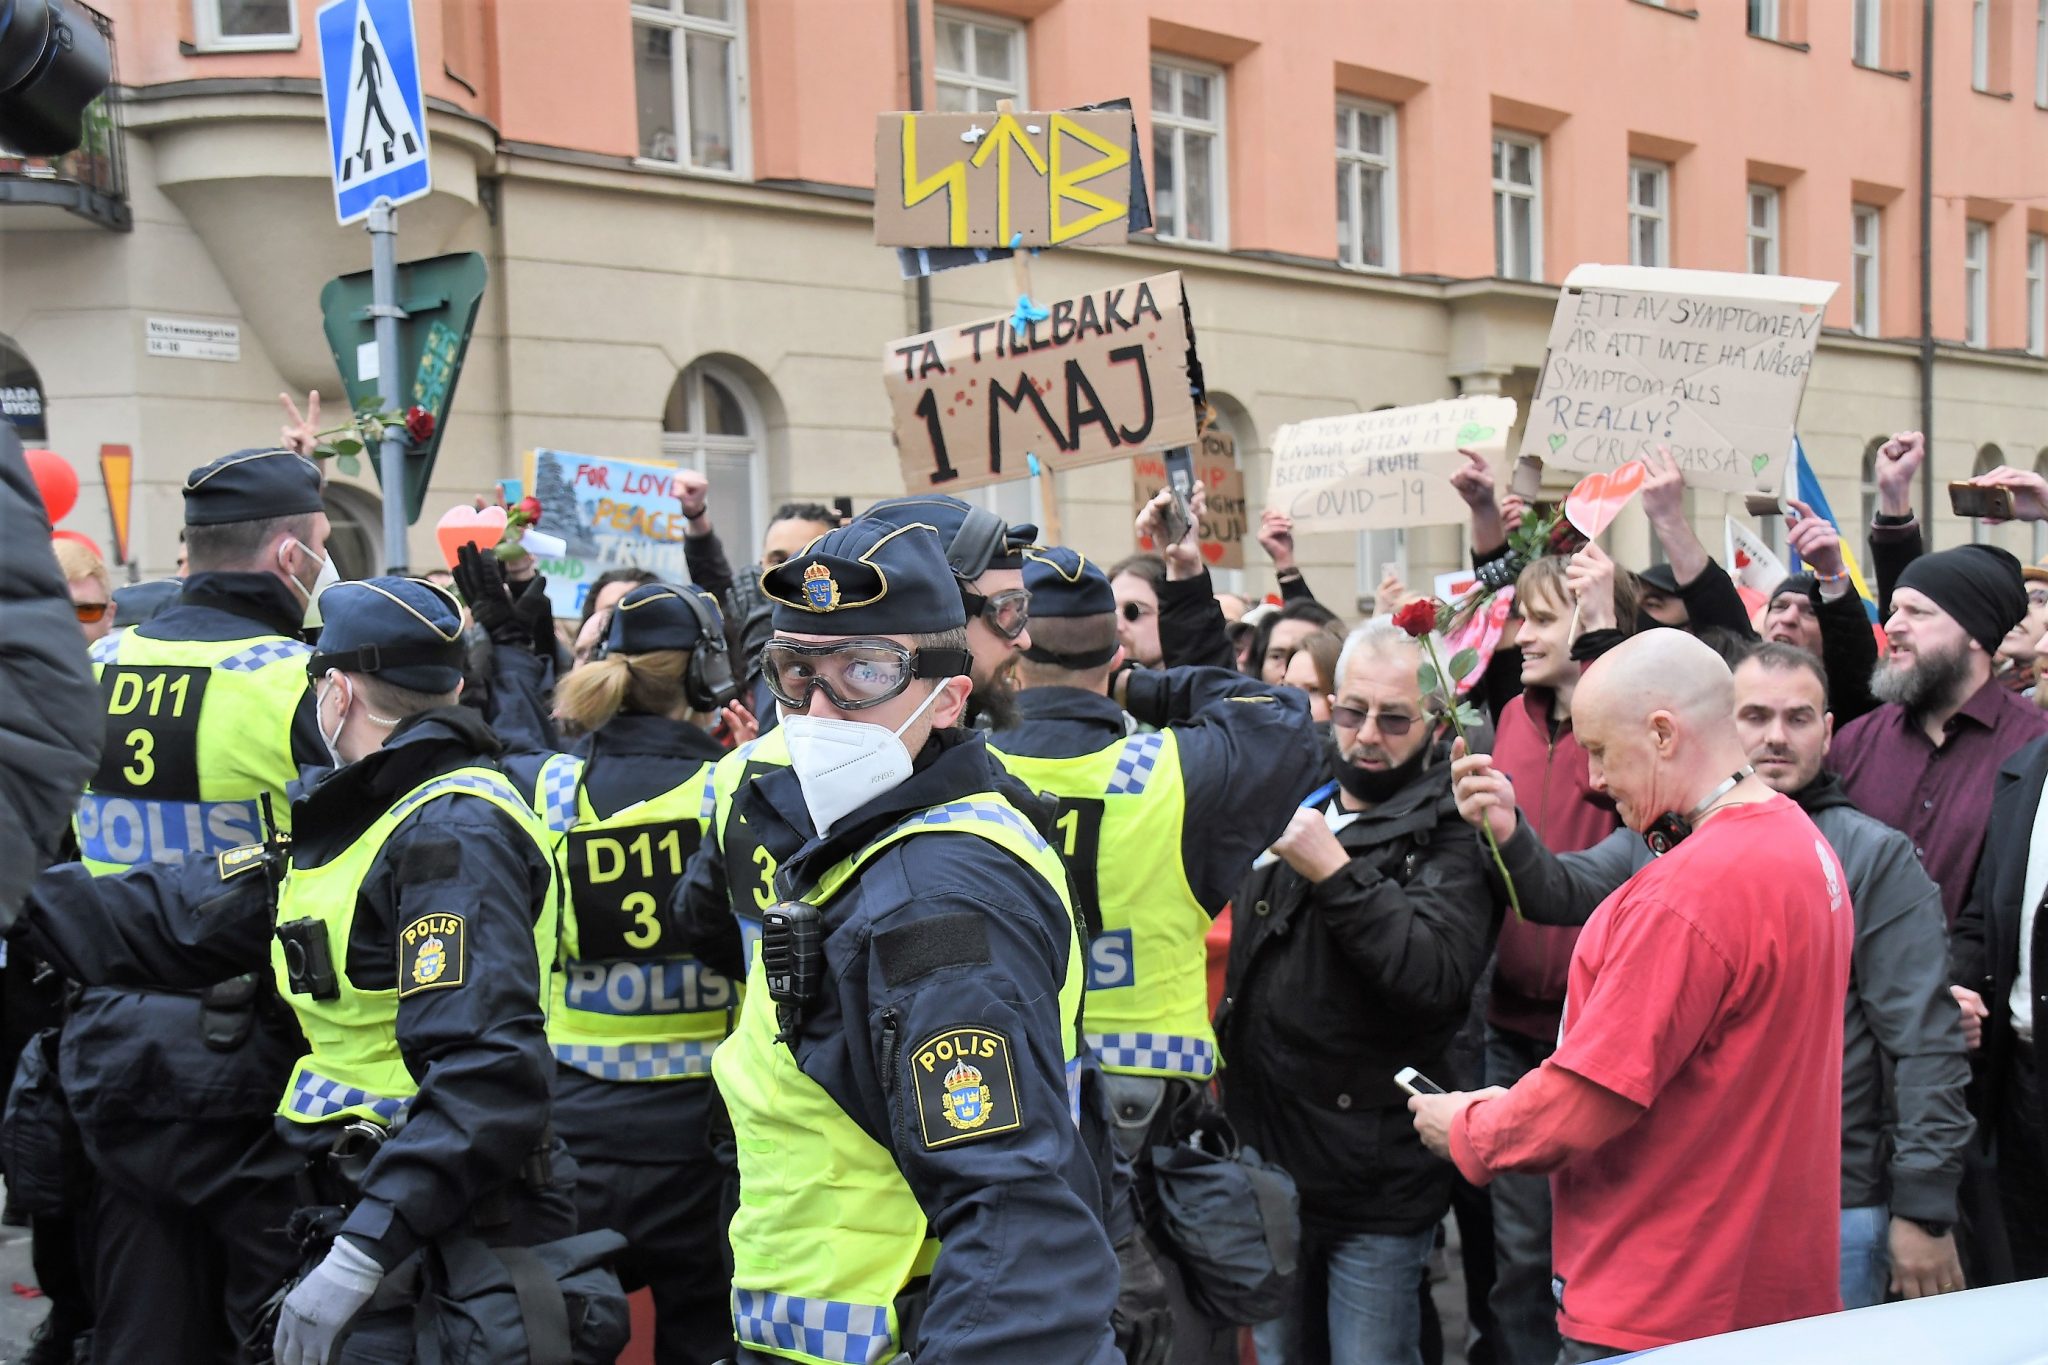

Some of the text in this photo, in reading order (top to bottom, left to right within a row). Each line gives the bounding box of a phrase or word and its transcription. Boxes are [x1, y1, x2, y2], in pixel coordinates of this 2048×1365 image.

[896, 282, 1162, 380] TA TILLBAKA
[1576, 291, 1820, 339] ETT AV SYMPTOMEN
[1565, 319, 1597, 353] ÄR
[1605, 329, 1650, 357] ATT
[1658, 338, 1709, 366] INTE
[1718, 344, 1747, 370] HA
[1545, 358, 1720, 405] SYMPTOM ALLS
[915, 344, 1154, 484] 1 MAJ
[1354, 413, 1419, 433] REPEAT
[1449, 406, 1479, 422] LIE
[1546, 395, 1680, 438] REALLY?
[1352, 431, 1410, 455] OFTEN
[1424, 430, 1443, 445] IT
[575, 464, 677, 498] FOR LOV
[1276, 461, 1349, 487] BECOMES
[592, 498, 685, 542] PEACE
[1289, 478, 1425, 519] COVID-19
[539, 559, 585, 579] AND
[107, 672, 190, 718] D11
[122, 728, 155, 786] 3
[80, 797, 252, 865] POLIS
[585, 829, 682, 884] D11
[752, 844, 778, 911] 3
[404, 917, 459, 945] POLIS
[621, 891, 662, 949] 3
[569, 961, 731, 1012] POLIS
[919, 1035, 998, 1073] POLIS
